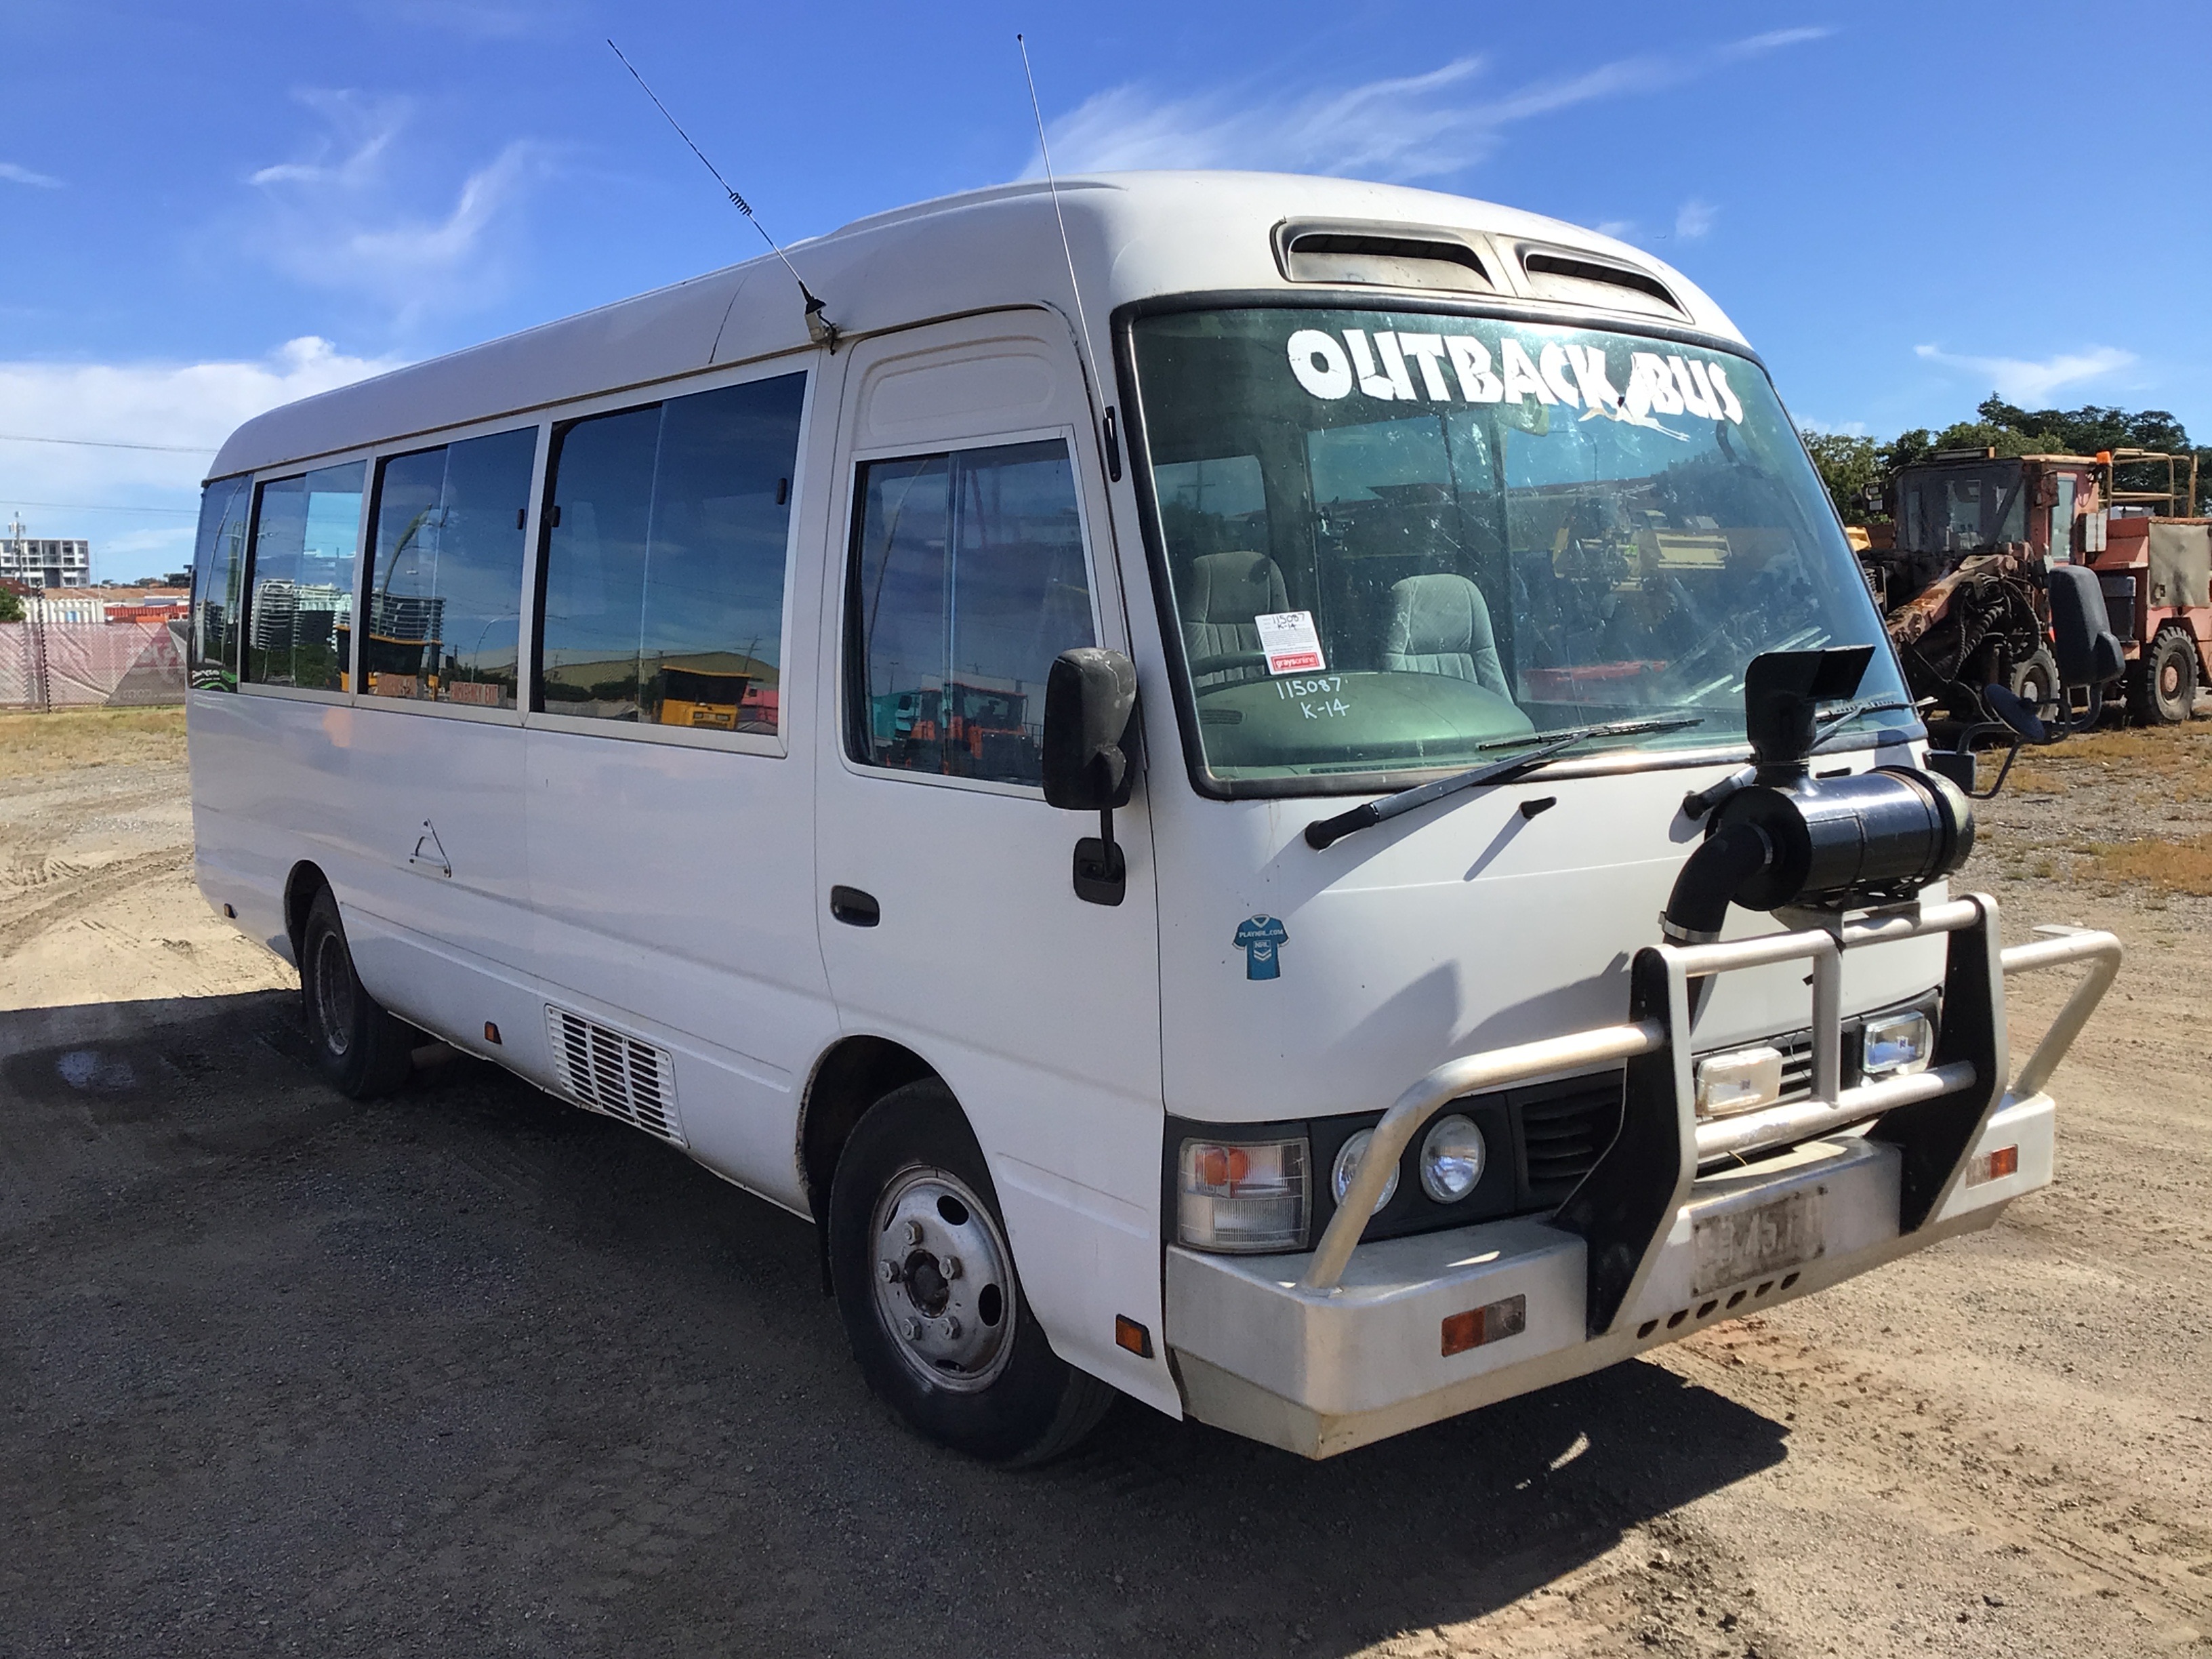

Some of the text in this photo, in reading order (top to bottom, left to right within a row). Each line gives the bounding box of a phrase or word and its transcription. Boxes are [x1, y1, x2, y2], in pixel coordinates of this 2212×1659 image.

[1286, 328, 1743, 425] OUTBACK BUS
[1272, 613, 1305, 624] 115087
[1276, 677, 1341, 699] 115087
[1300, 697, 1350, 719] K-14
